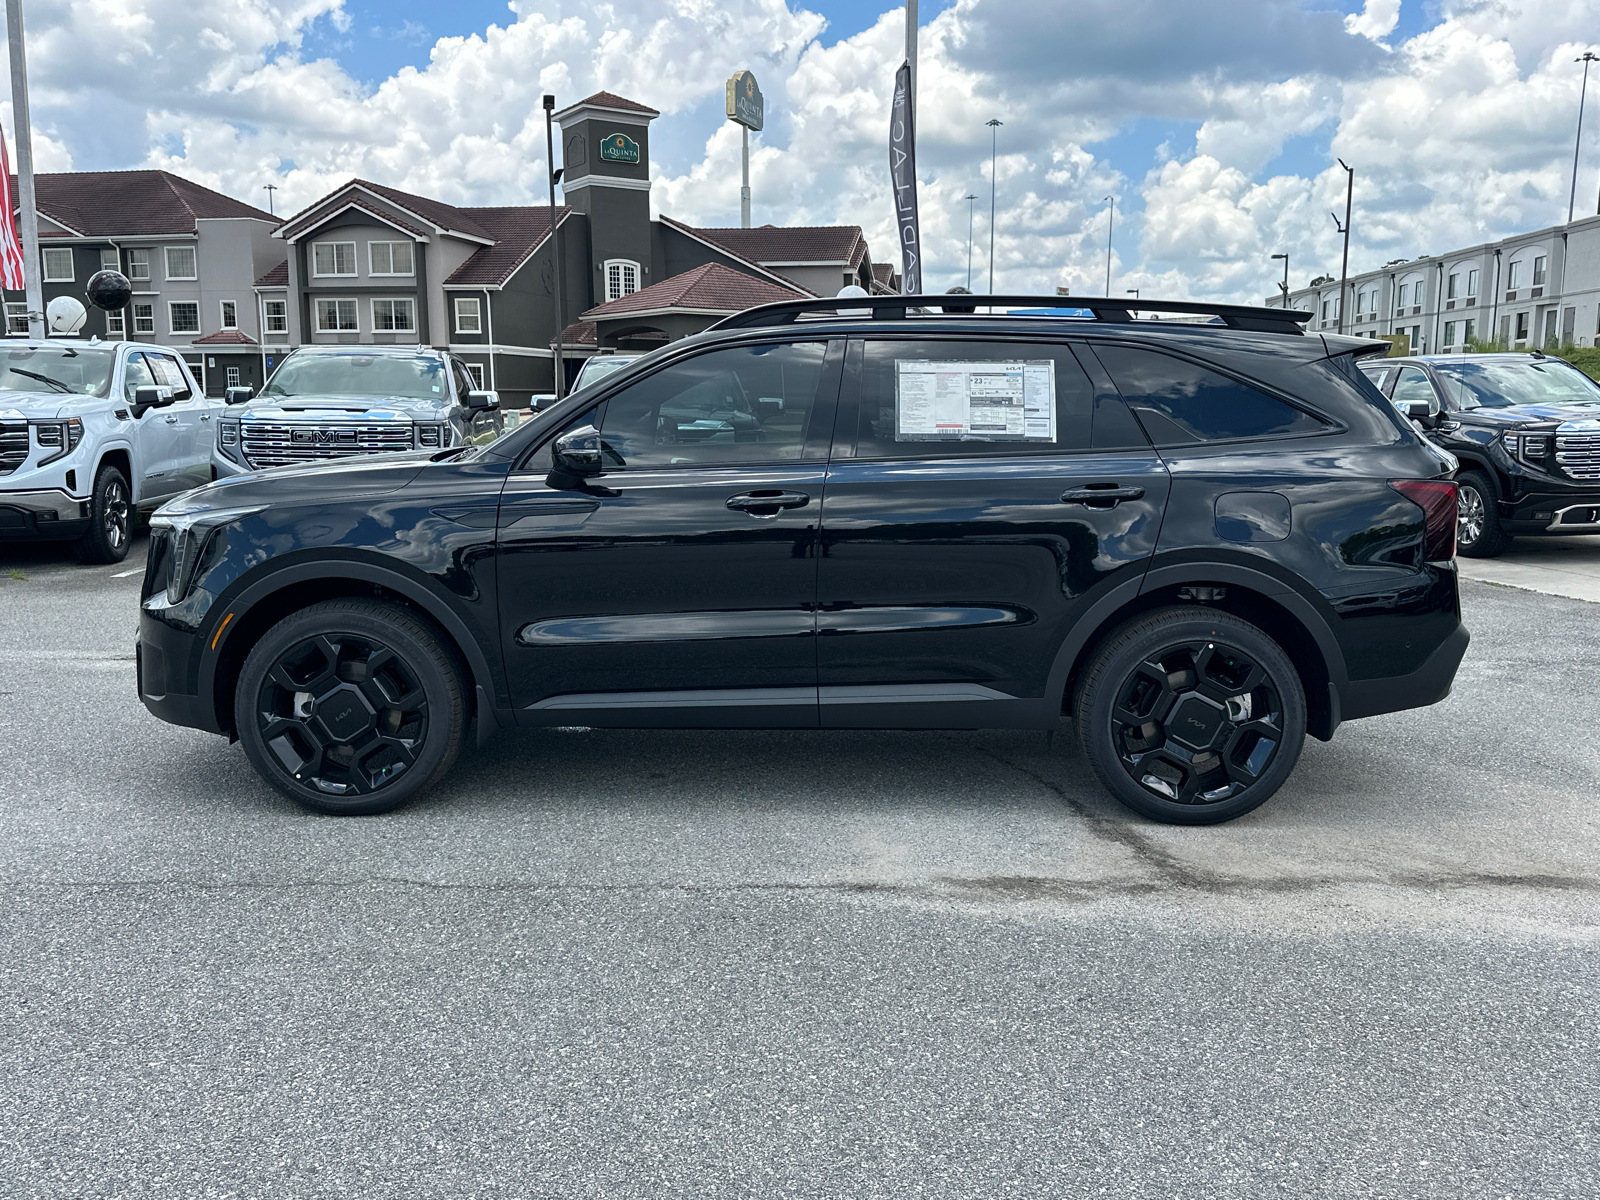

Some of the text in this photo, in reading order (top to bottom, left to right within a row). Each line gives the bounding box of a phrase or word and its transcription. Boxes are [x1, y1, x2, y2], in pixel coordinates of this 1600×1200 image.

[740, 96, 762, 119] QUINTA
[609, 147, 638, 157] QUINTA
[293, 430, 355, 443] GMC
